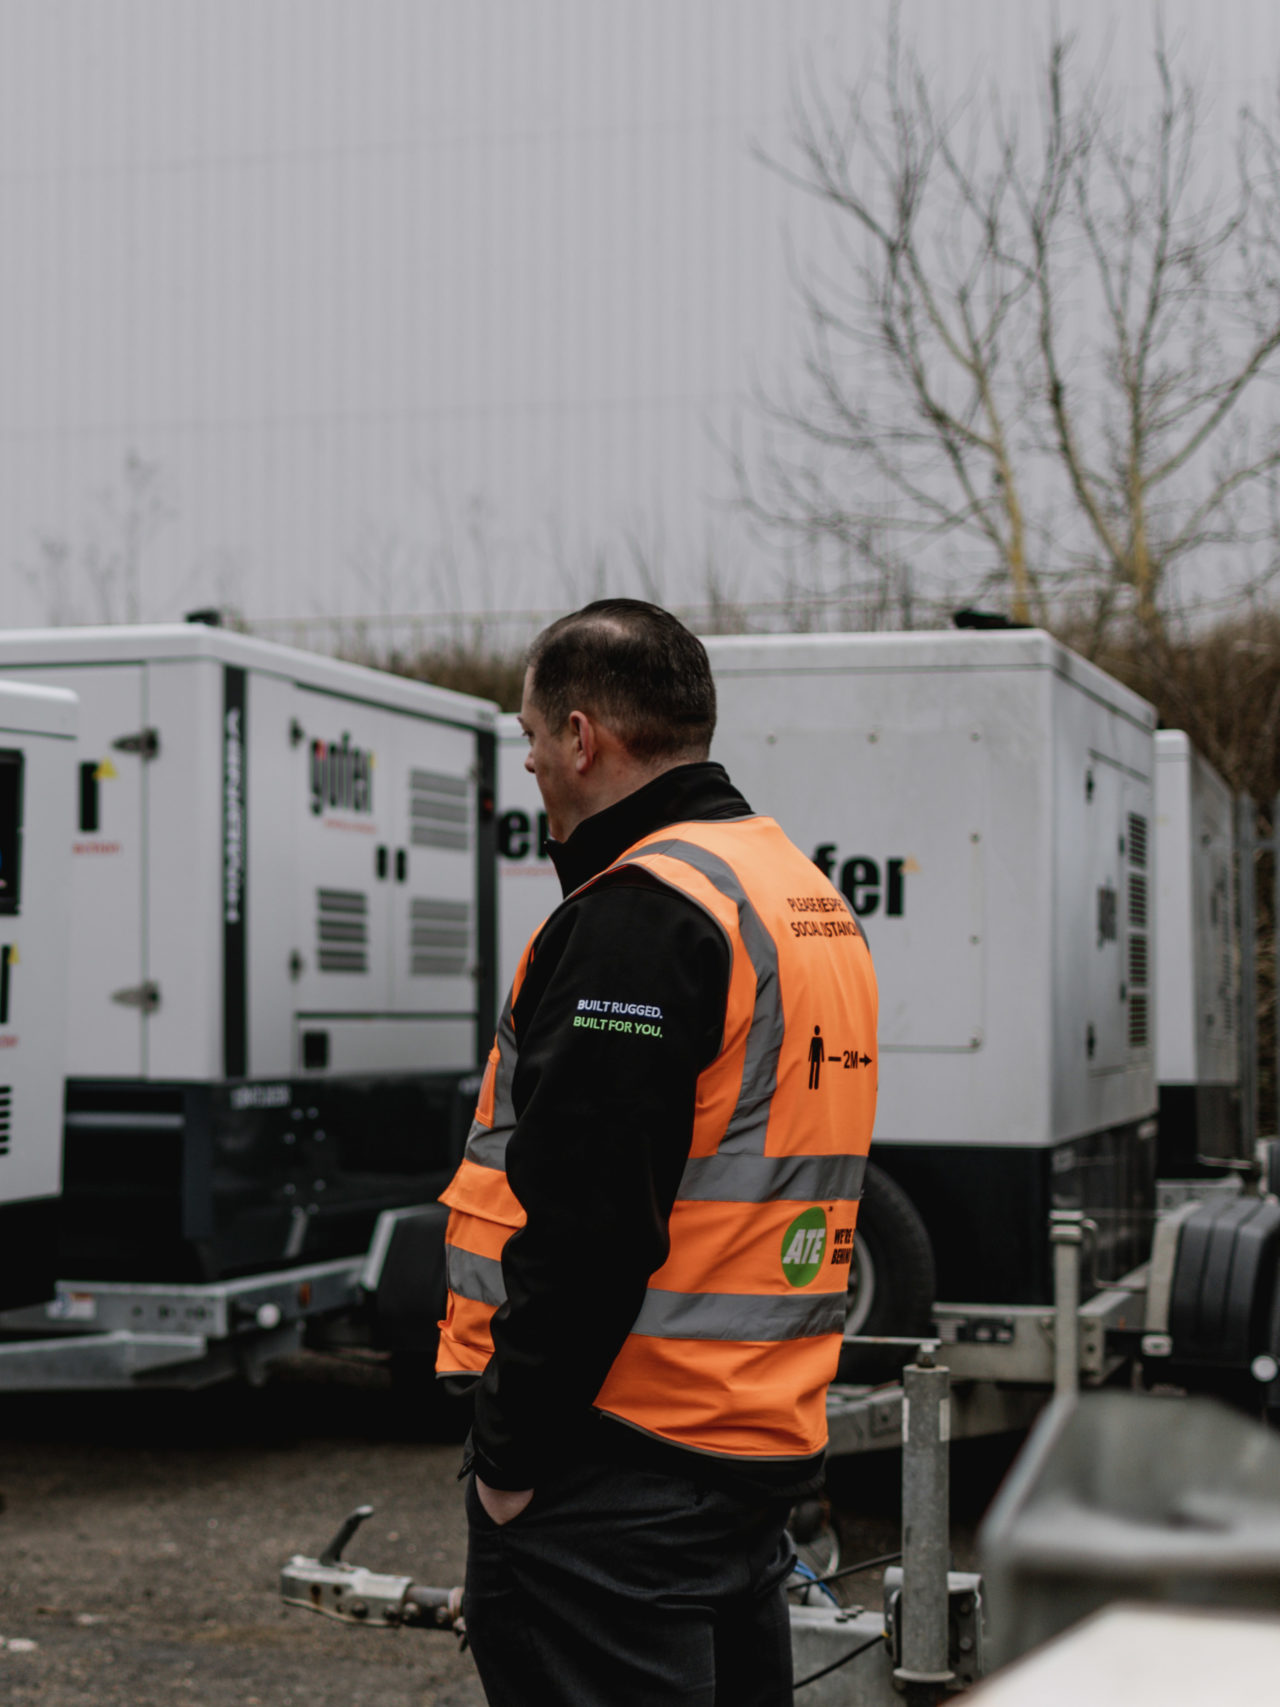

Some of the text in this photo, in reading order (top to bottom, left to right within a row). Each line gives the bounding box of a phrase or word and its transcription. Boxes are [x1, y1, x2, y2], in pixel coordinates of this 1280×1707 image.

[786, 897, 819, 912] PLEASE
[577, 999, 663, 1019] BUILT RUGGED.
[573, 1016, 663, 1038] BUILT FOR YOU.
[843, 1050, 858, 1069] 2M
[782, 1228, 825, 1264] ATE
